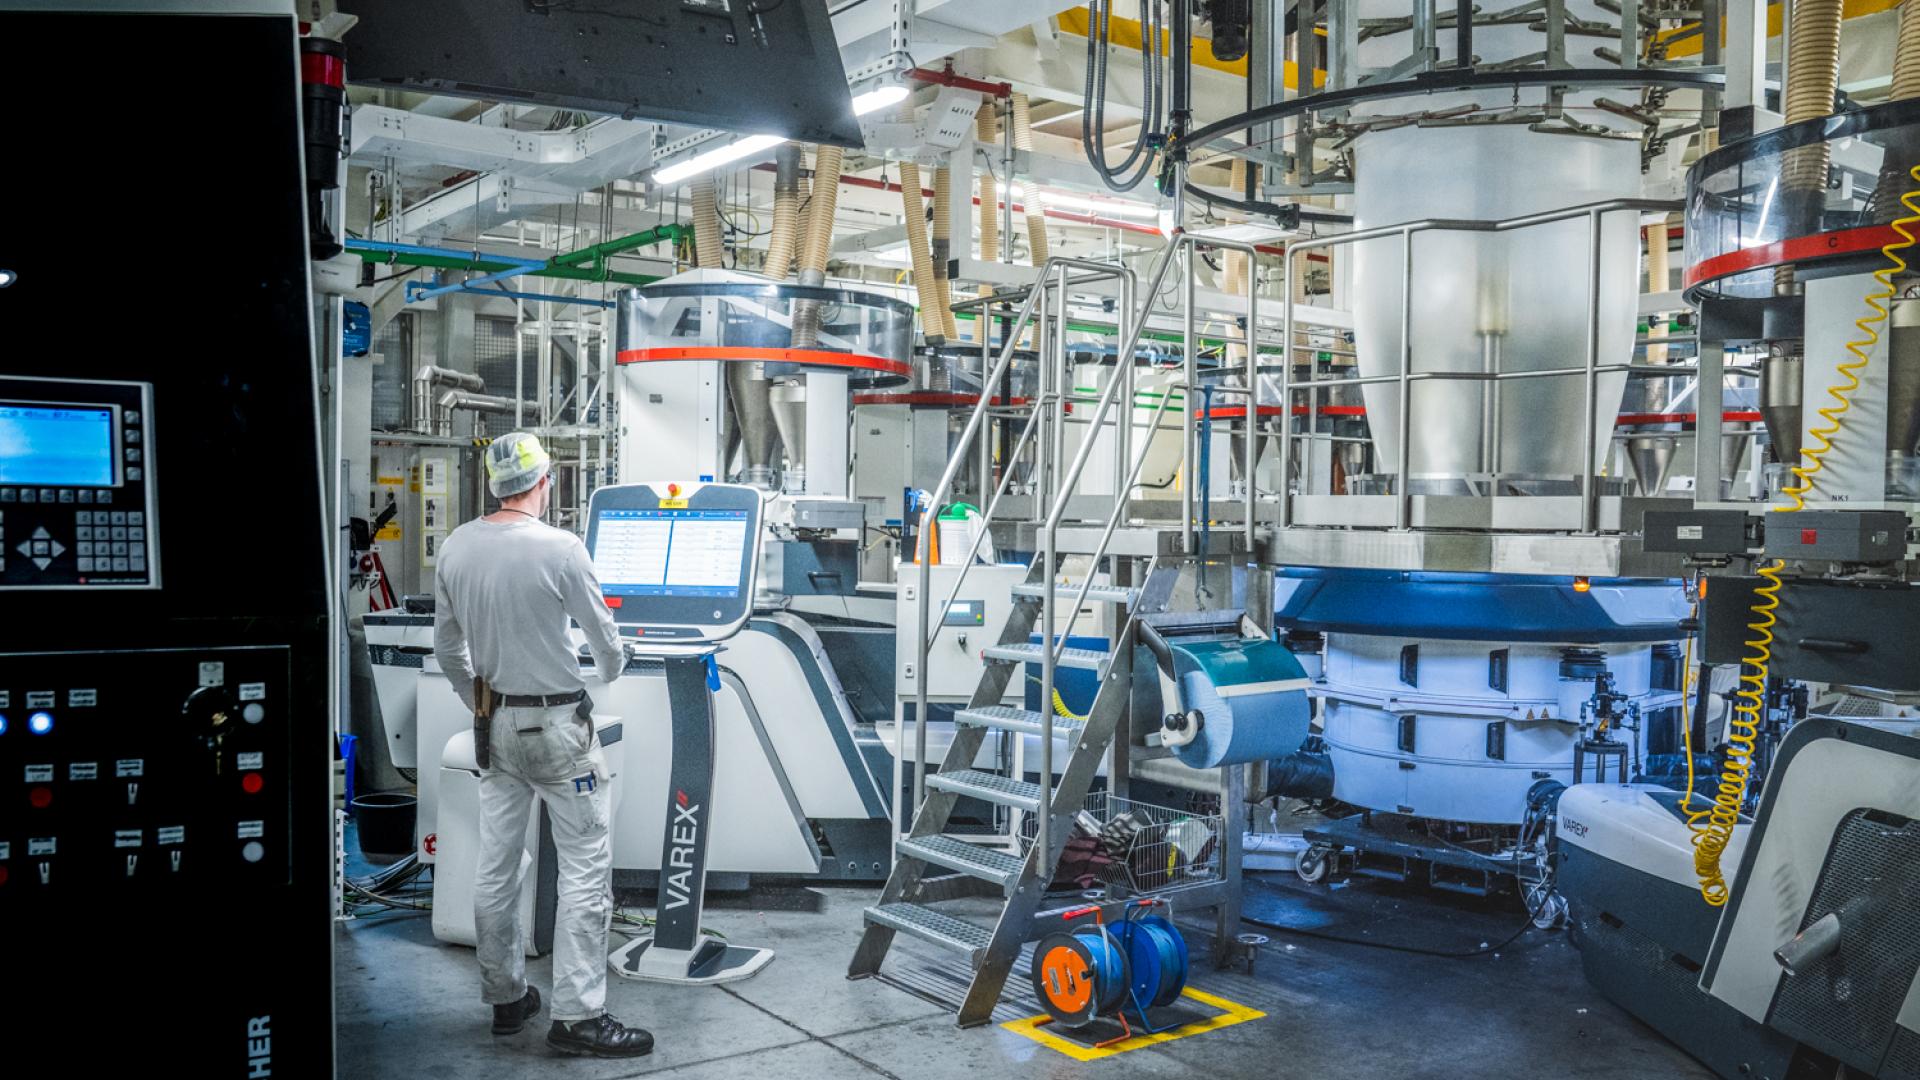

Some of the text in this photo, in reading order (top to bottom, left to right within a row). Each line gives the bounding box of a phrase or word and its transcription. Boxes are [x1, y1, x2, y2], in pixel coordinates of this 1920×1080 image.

[1828, 237, 1838, 248] C
[1563, 816, 1585, 838] VAREX
[664, 803, 700, 910] VAREX
